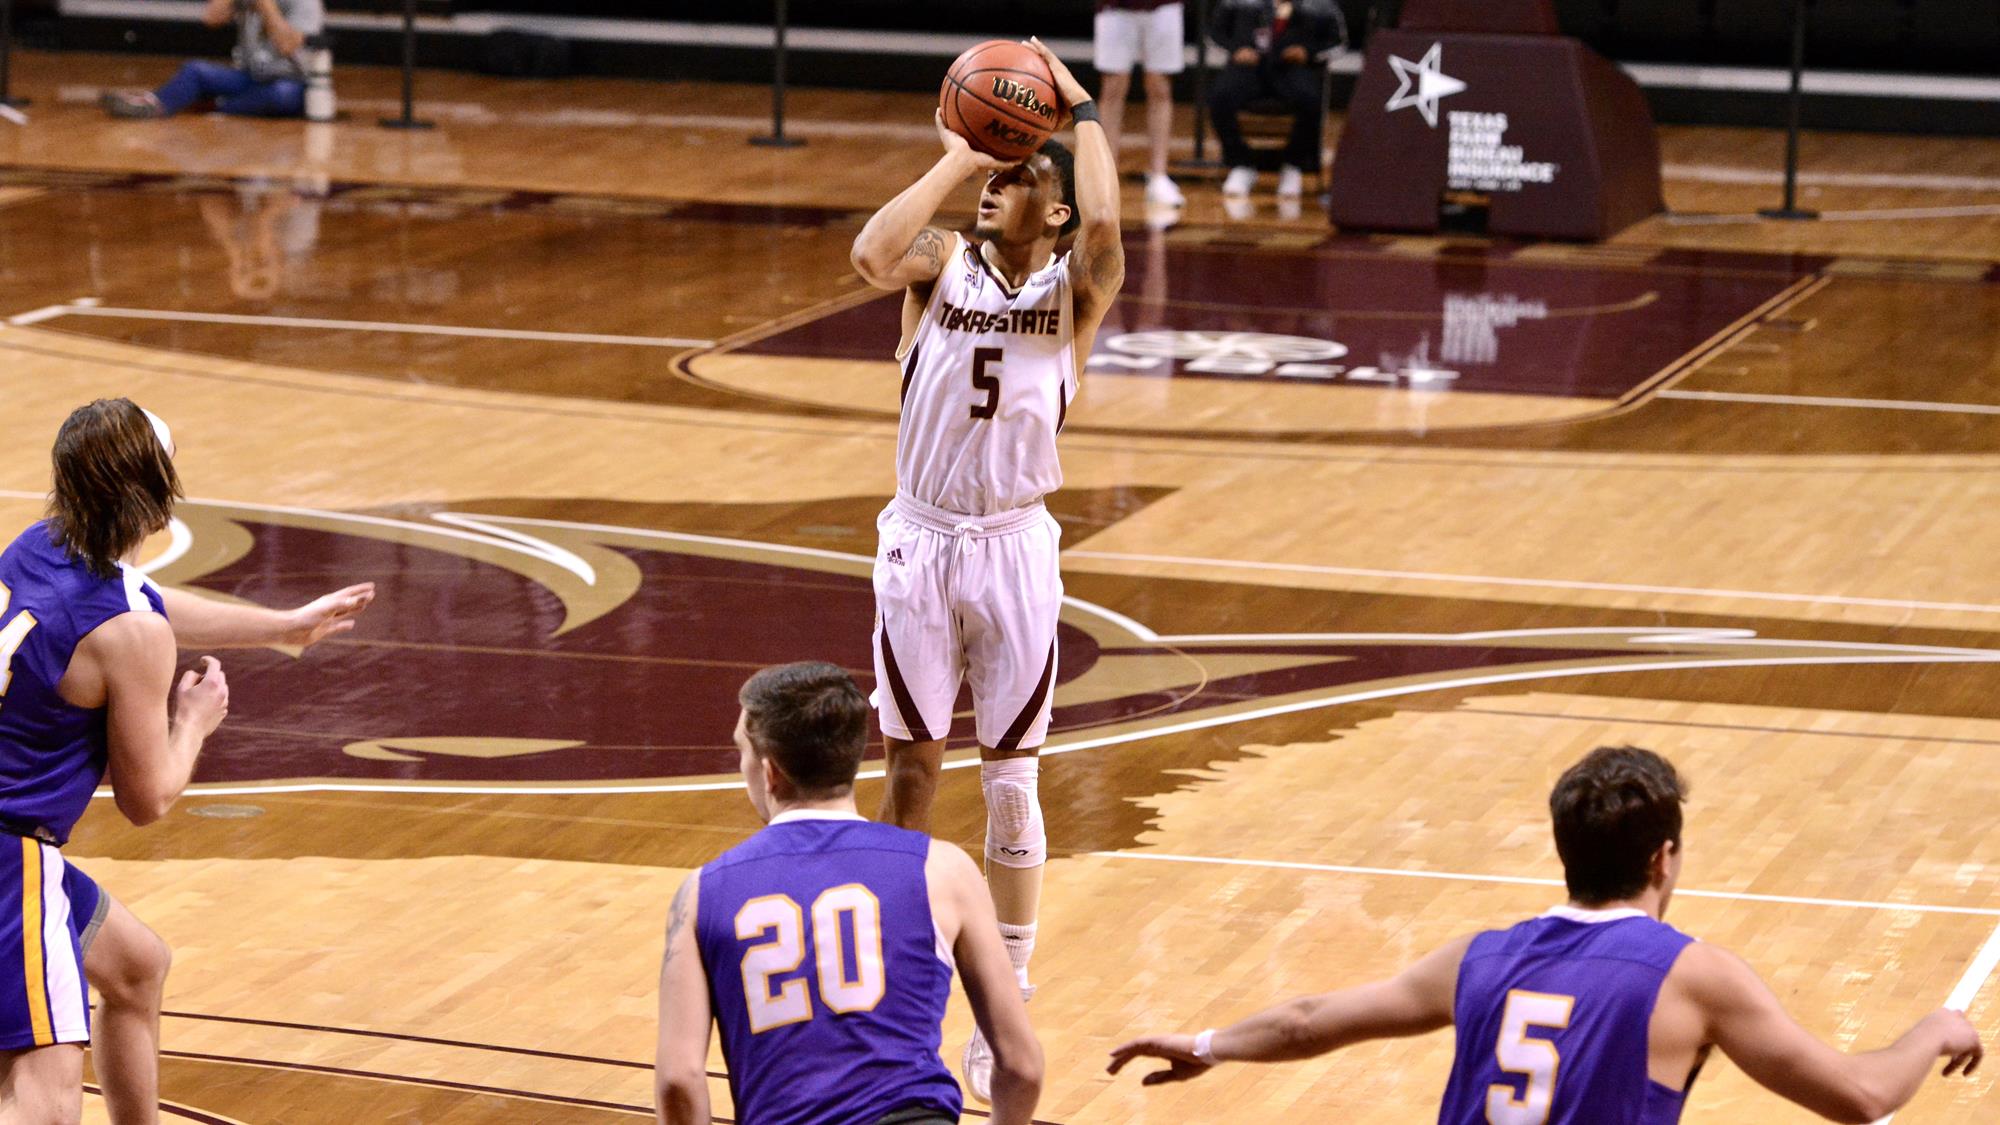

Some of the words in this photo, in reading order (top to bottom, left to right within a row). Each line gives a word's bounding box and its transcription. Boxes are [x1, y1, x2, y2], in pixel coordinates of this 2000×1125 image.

[993, 76, 1055, 121] Wilson
[984, 119, 1039, 147] NCAA
[1447, 111, 1507, 131] TEXAS
[1448, 144, 1523, 163] BUREAU
[994, 309, 1060, 335] STATE
[970, 347, 1003, 420] 5
[734, 883, 886, 1035] 20
[1485, 988, 1575, 1125] 5
